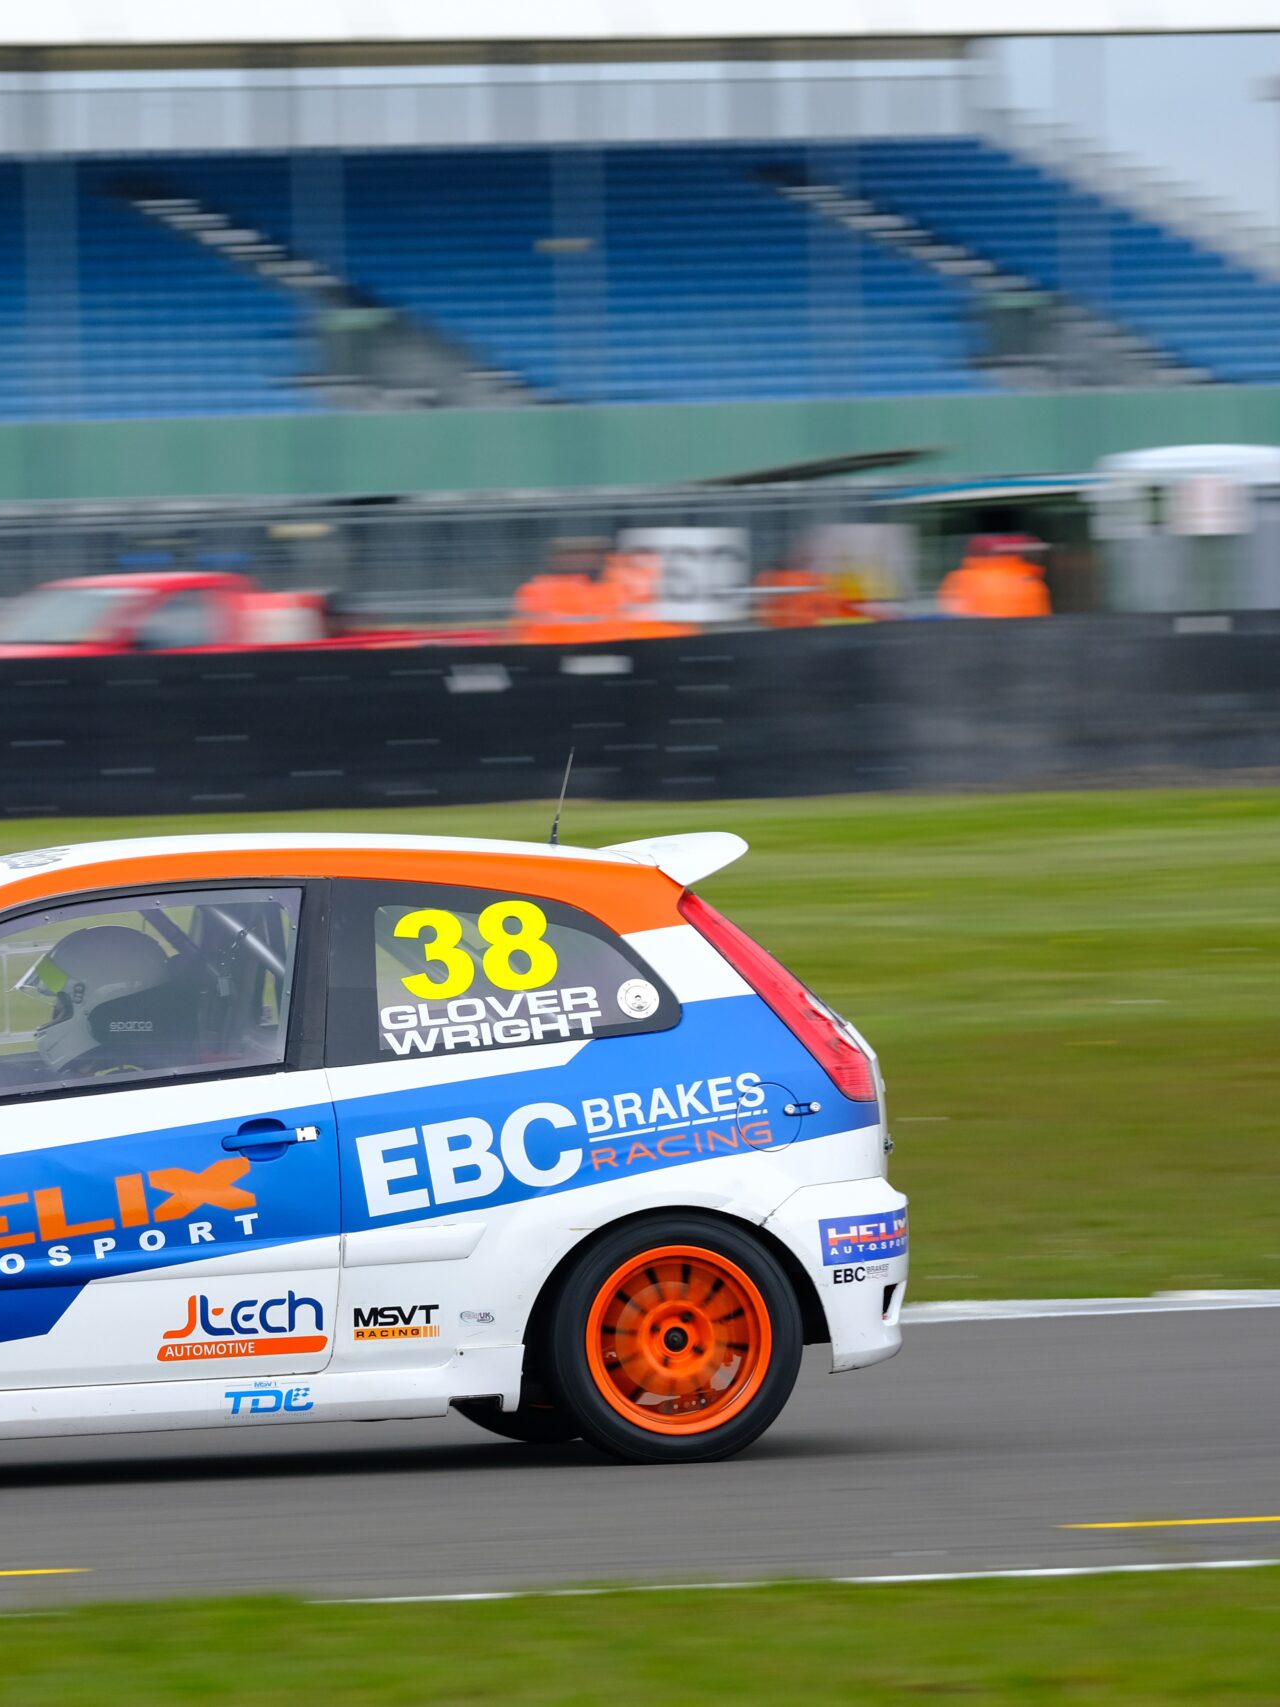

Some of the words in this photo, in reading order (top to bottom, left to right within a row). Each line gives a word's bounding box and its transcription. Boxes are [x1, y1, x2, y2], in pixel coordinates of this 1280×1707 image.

[393, 900, 559, 1000] 38
[110, 1021, 153, 1032] sparco
[380, 986, 599, 1030] GLOVER
[383, 1011, 602, 1056] WRIGHT
[582, 1072, 766, 1134] BRAKES
[356, 1102, 583, 1218] EBC
[591, 1121, 773, 1171] RACING
[833, 1266, 866, 1284] EBC
[354, 1304, 440, 1328] MSVT
[356, 1328, 420, 1338] RACING
[165, 1342, 255, 1358] AUTOMOTIVE
